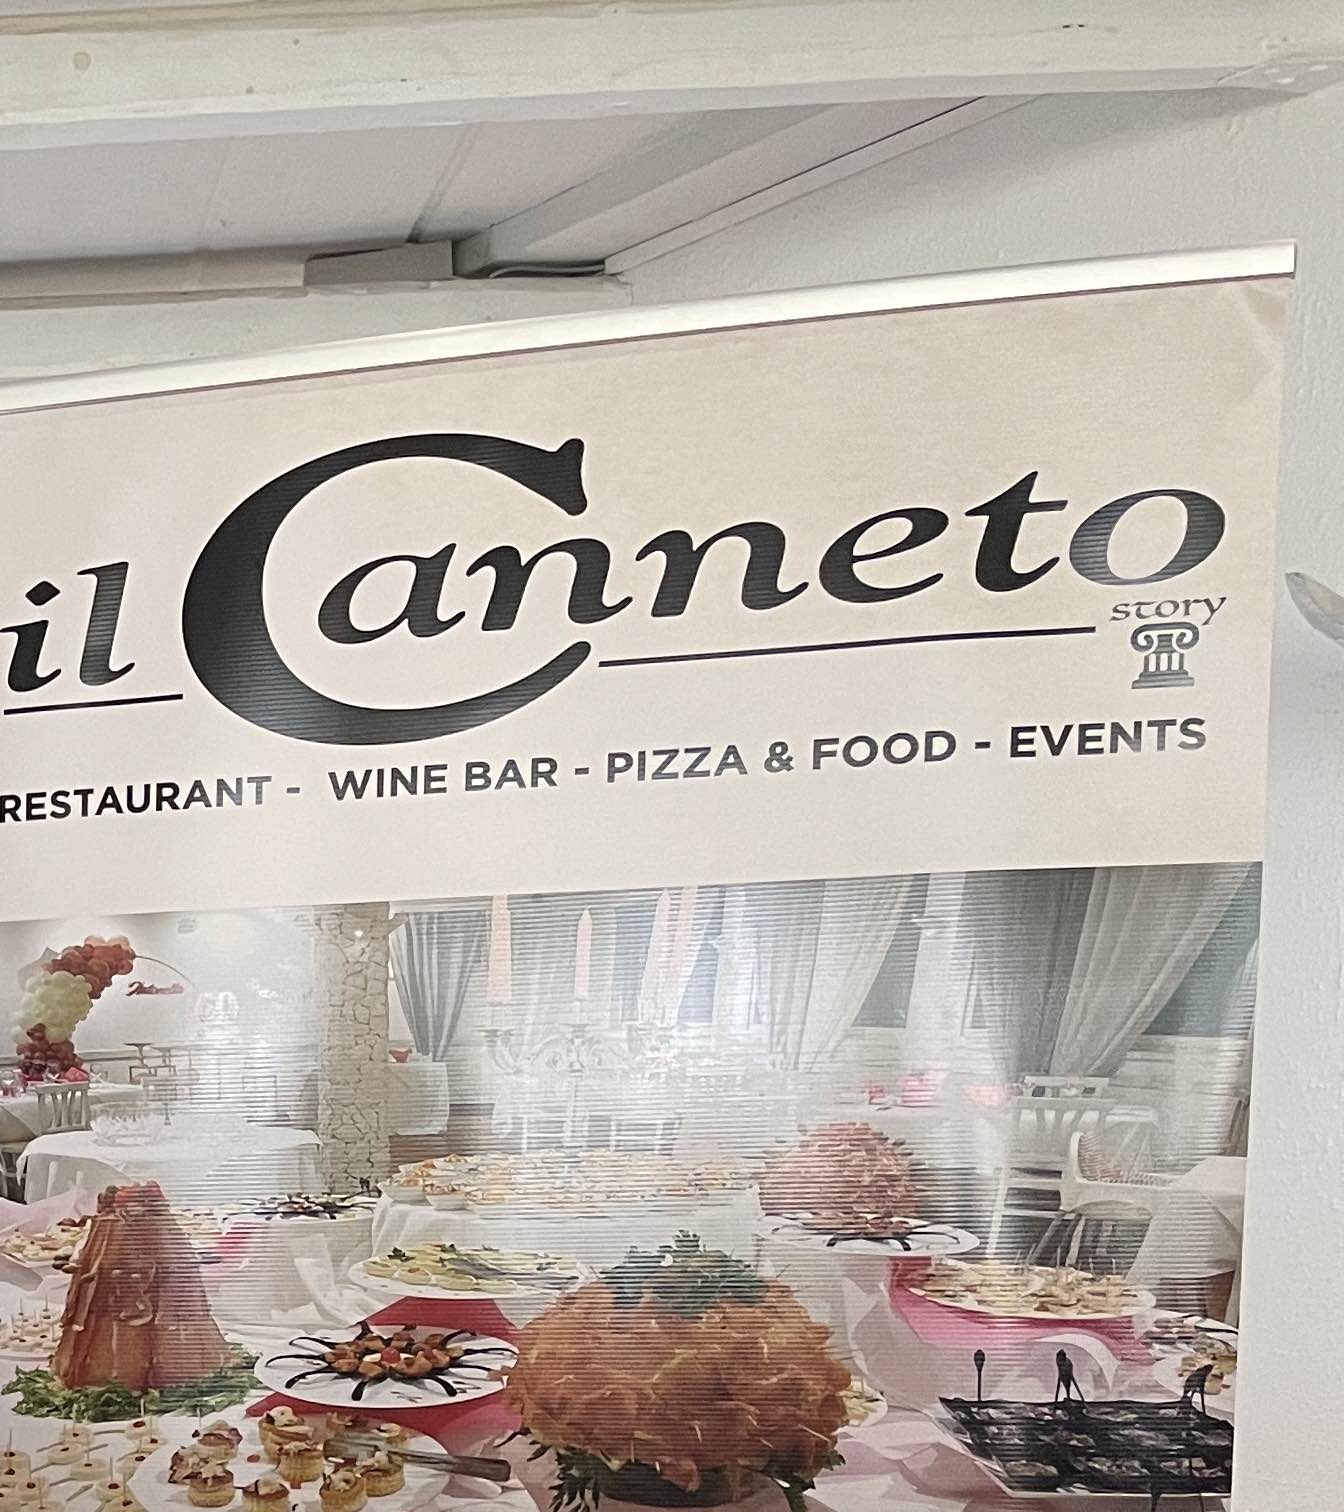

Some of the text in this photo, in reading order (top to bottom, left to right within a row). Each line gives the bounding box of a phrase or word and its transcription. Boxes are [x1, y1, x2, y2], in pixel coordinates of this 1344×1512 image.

[0, 432, 1227, 747] il Canneto
[1109, 596, 1227, 626] story
[327, 763, 448, 801] WINE
[464, 757, 558, 792] BAR
[607, 744, 748, 783] PIZZA
[764, 741, 794, 772] &
[812, 730, 957, 770] FOOD
[1009, 717, 1206, 758] EVENTS
